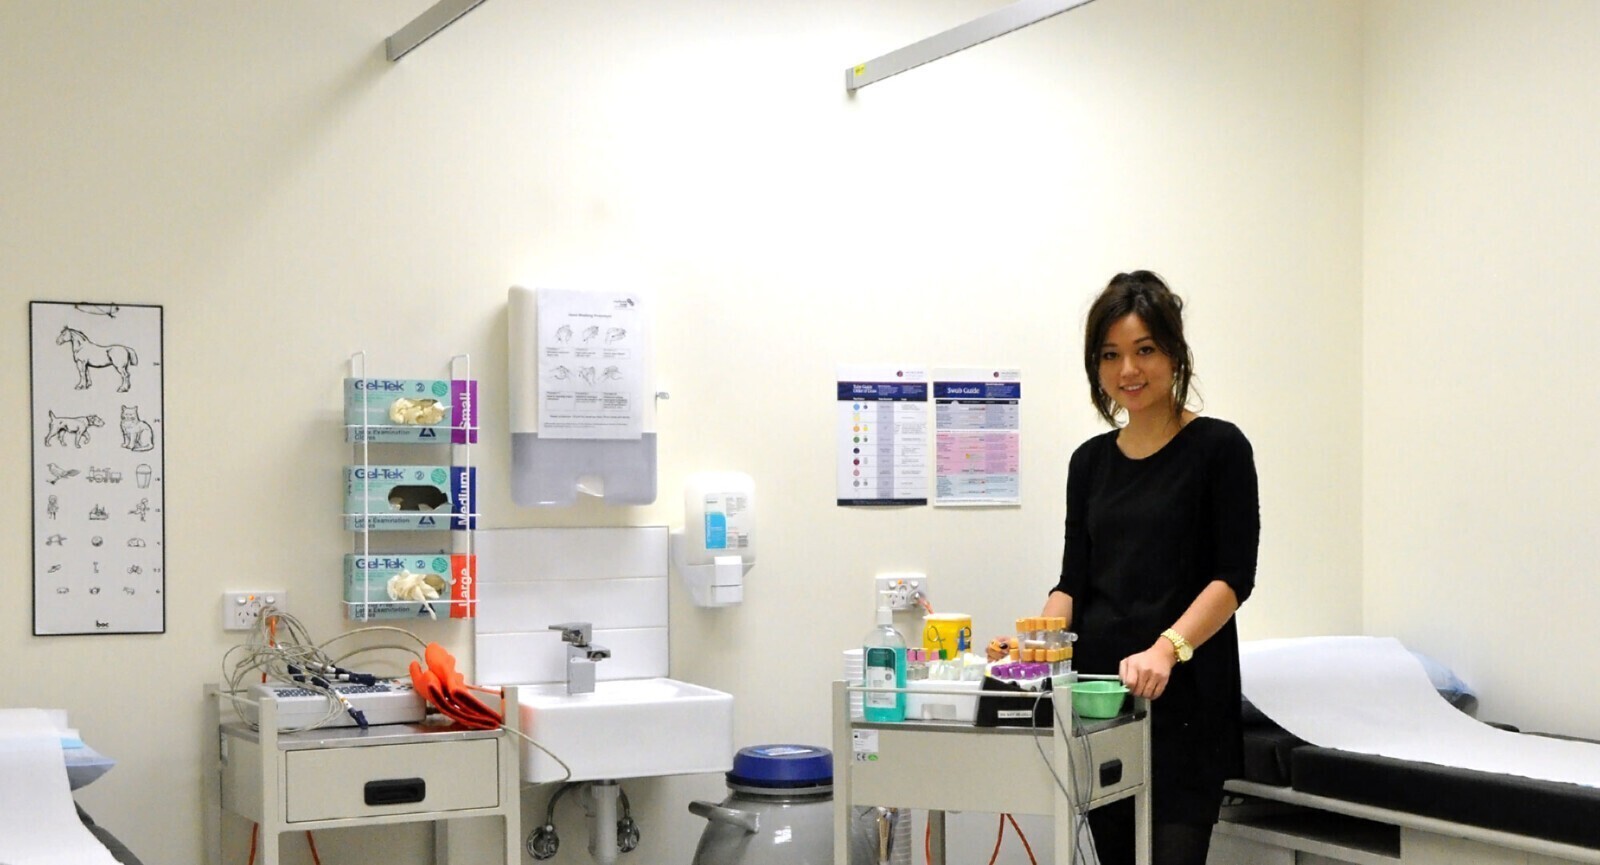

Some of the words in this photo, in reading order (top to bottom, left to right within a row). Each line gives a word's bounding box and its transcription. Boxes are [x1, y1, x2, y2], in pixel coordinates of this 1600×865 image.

[354, 379, 405, 392] Gel-Tek
[459, 392, 471, 430] Small
[354, 468, 404, 480] Gel-Tek
[458, 472, 469, 526] Medium
[355, 558, 405, 570] Gel-Tek
